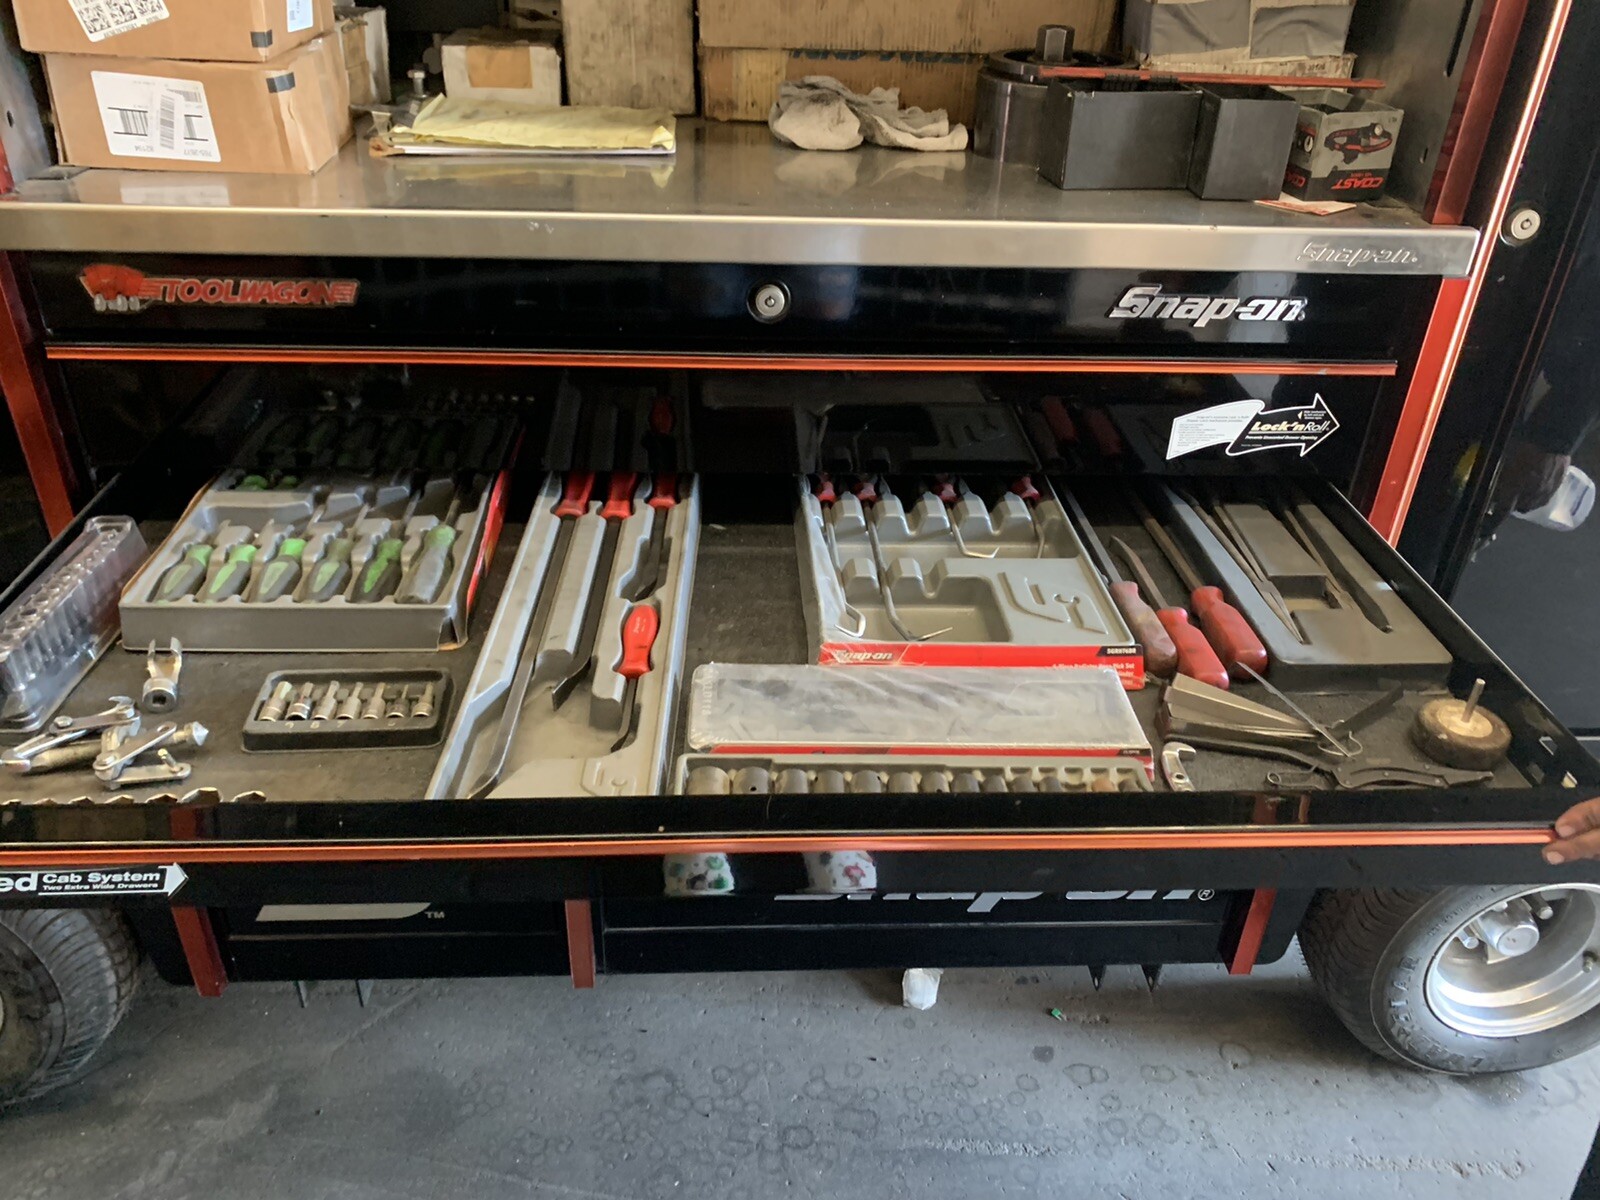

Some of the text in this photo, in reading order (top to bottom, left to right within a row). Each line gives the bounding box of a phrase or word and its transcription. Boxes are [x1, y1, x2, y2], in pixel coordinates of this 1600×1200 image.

[1331, 177, 1384, 190] COAST
[1297, 241, 1411, 267] Snap-on
[160, 278, 337, 305] TOOLWAGON
[1108, 284, 1305, 328] Snap-on
[42, 871, 161, 885] Cab System
[92, 883, 115, 891] Wide
[117, 882, 159, 890] Drawers
